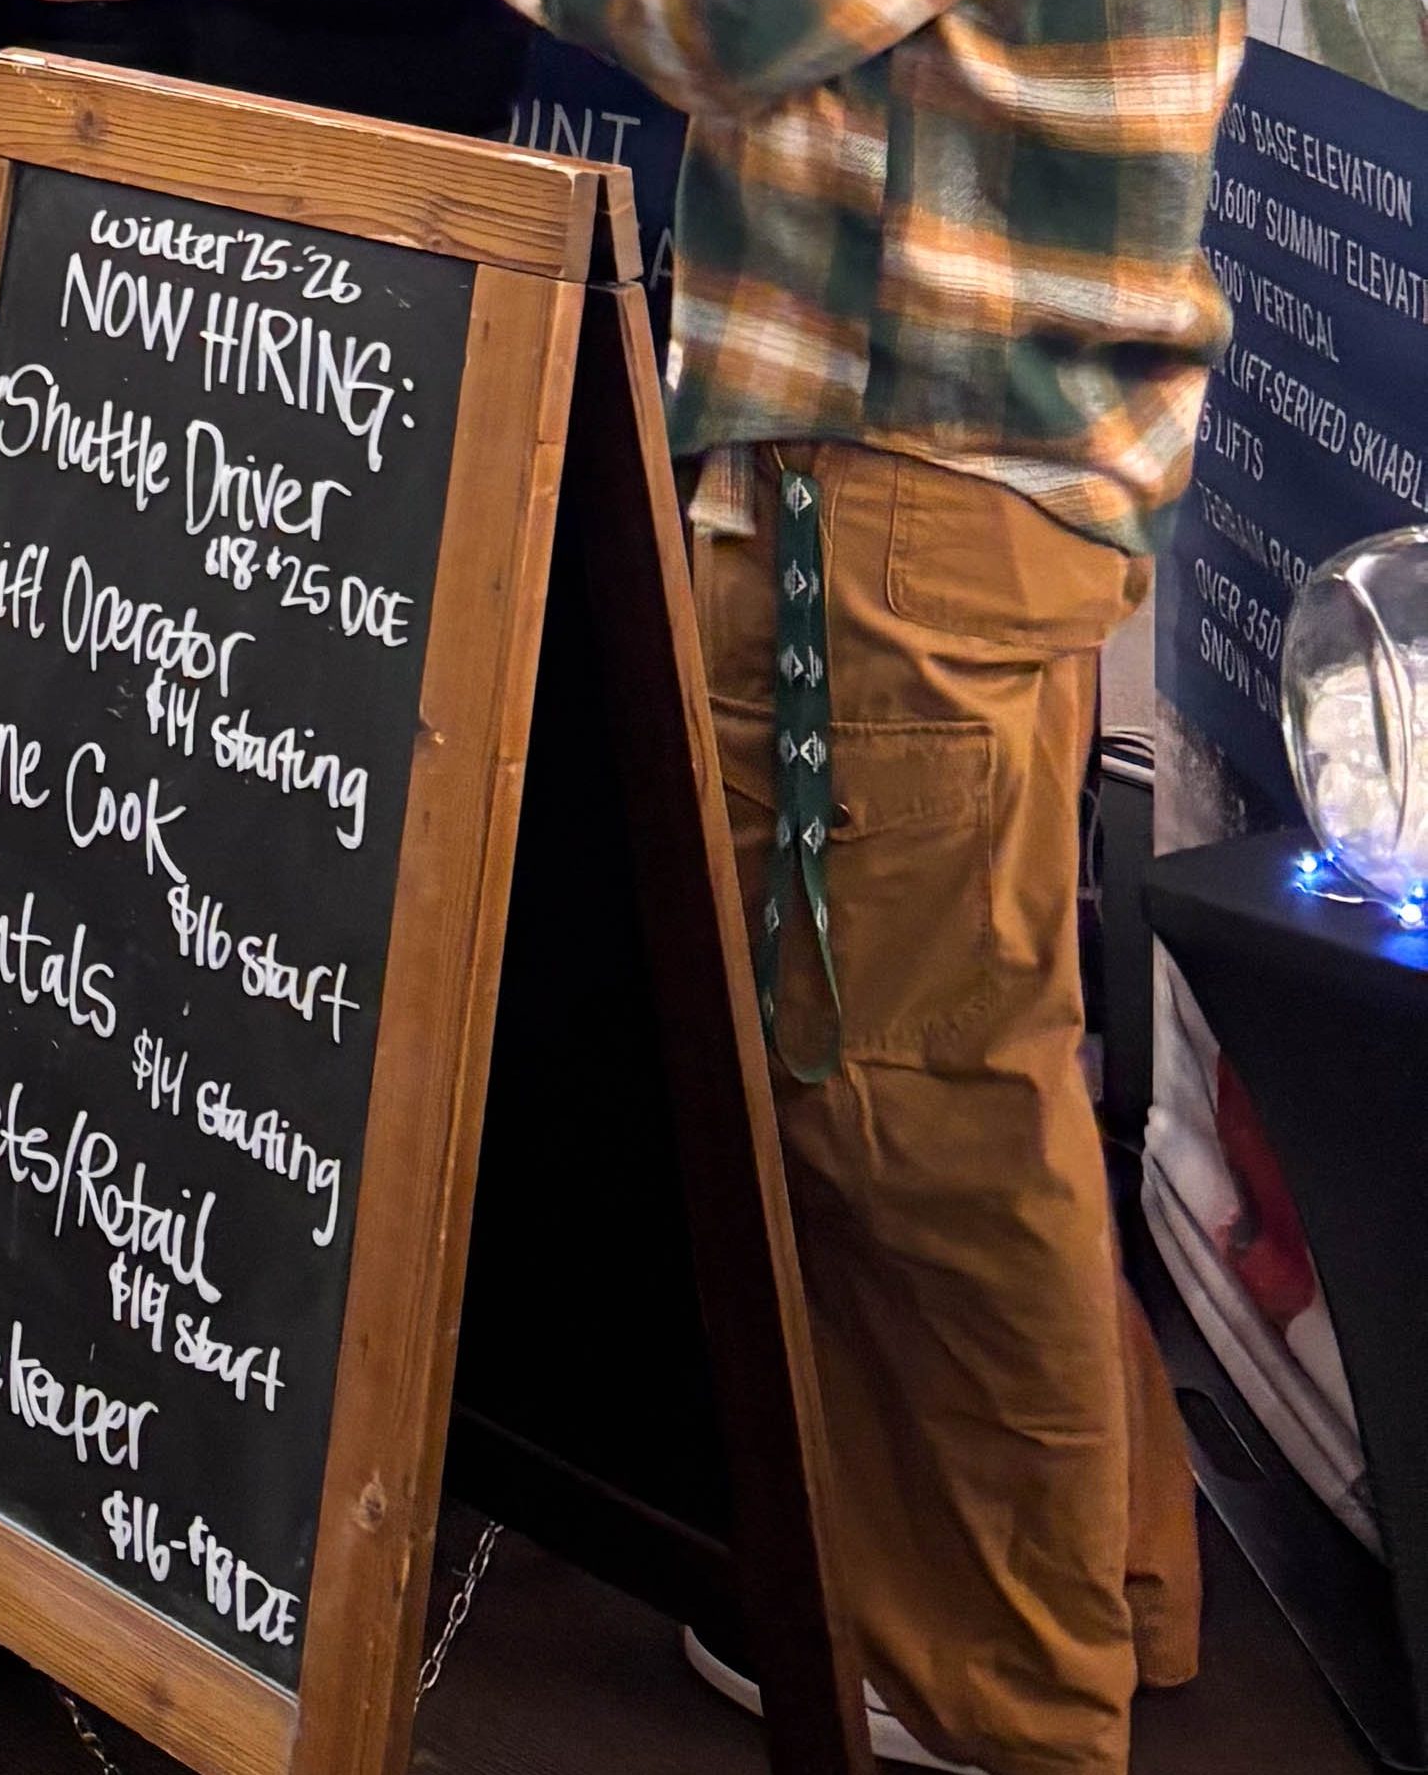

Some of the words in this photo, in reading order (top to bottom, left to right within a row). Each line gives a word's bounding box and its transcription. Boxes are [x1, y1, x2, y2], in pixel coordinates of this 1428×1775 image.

[1251, 110, 1300, 171] BASE
[1303, 133, 1413, 227] ELEVATION
[1265, 198, 1341, 275] SUMMIT
[60, 252, 195, 362] NOW
[199, 291, 415, 473] HIRING:
[1250, 271, 1340, 363] VERTICAL
[1230, 343, 1347, 454] LIFT-SERVED
[185, 419, 352, 542] Driver
[1215, 411, 1264, 481] LIFTS
[63, 555, 256, 698] Operator
[340, 576, 415, 647] DOE
[1195, 558, 1241, 629] OVER
[1244, 598, 1282, 661] 350
[1200, 618, 1250, 697] SNOW
[145, 668, 201, 757] $14
[65, 742, 188, 884] Cook
[166, 882, 231, 970] $16
[132, 1027, 188, 1116] $14
